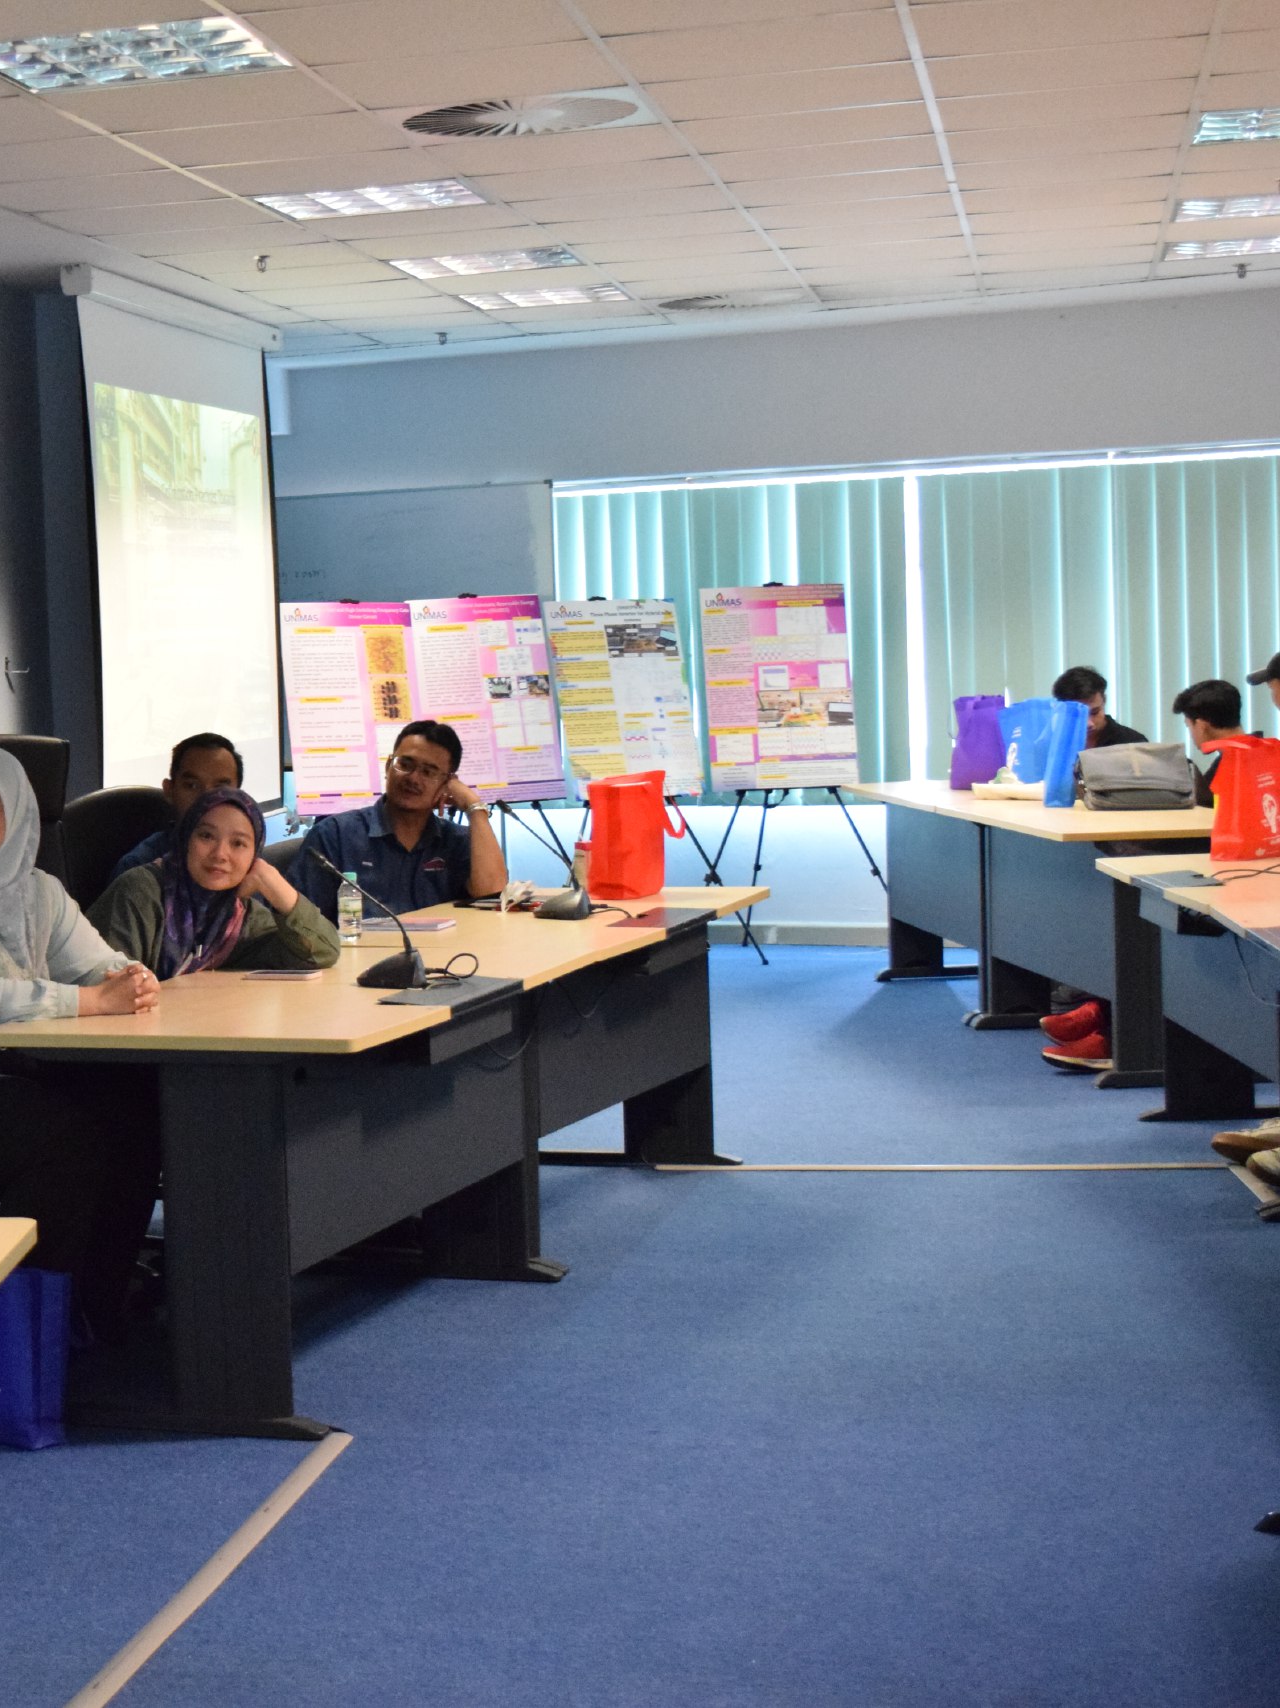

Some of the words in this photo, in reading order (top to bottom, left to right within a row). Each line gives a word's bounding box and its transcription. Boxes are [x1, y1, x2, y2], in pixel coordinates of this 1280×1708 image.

[705, 596, 742, 608] UNIMAS
[284, 611, 319, 622] UNIMAS
[413, 609, 447, 620] UNIMAS
[550, 608, 583, 619] UNIMAS
